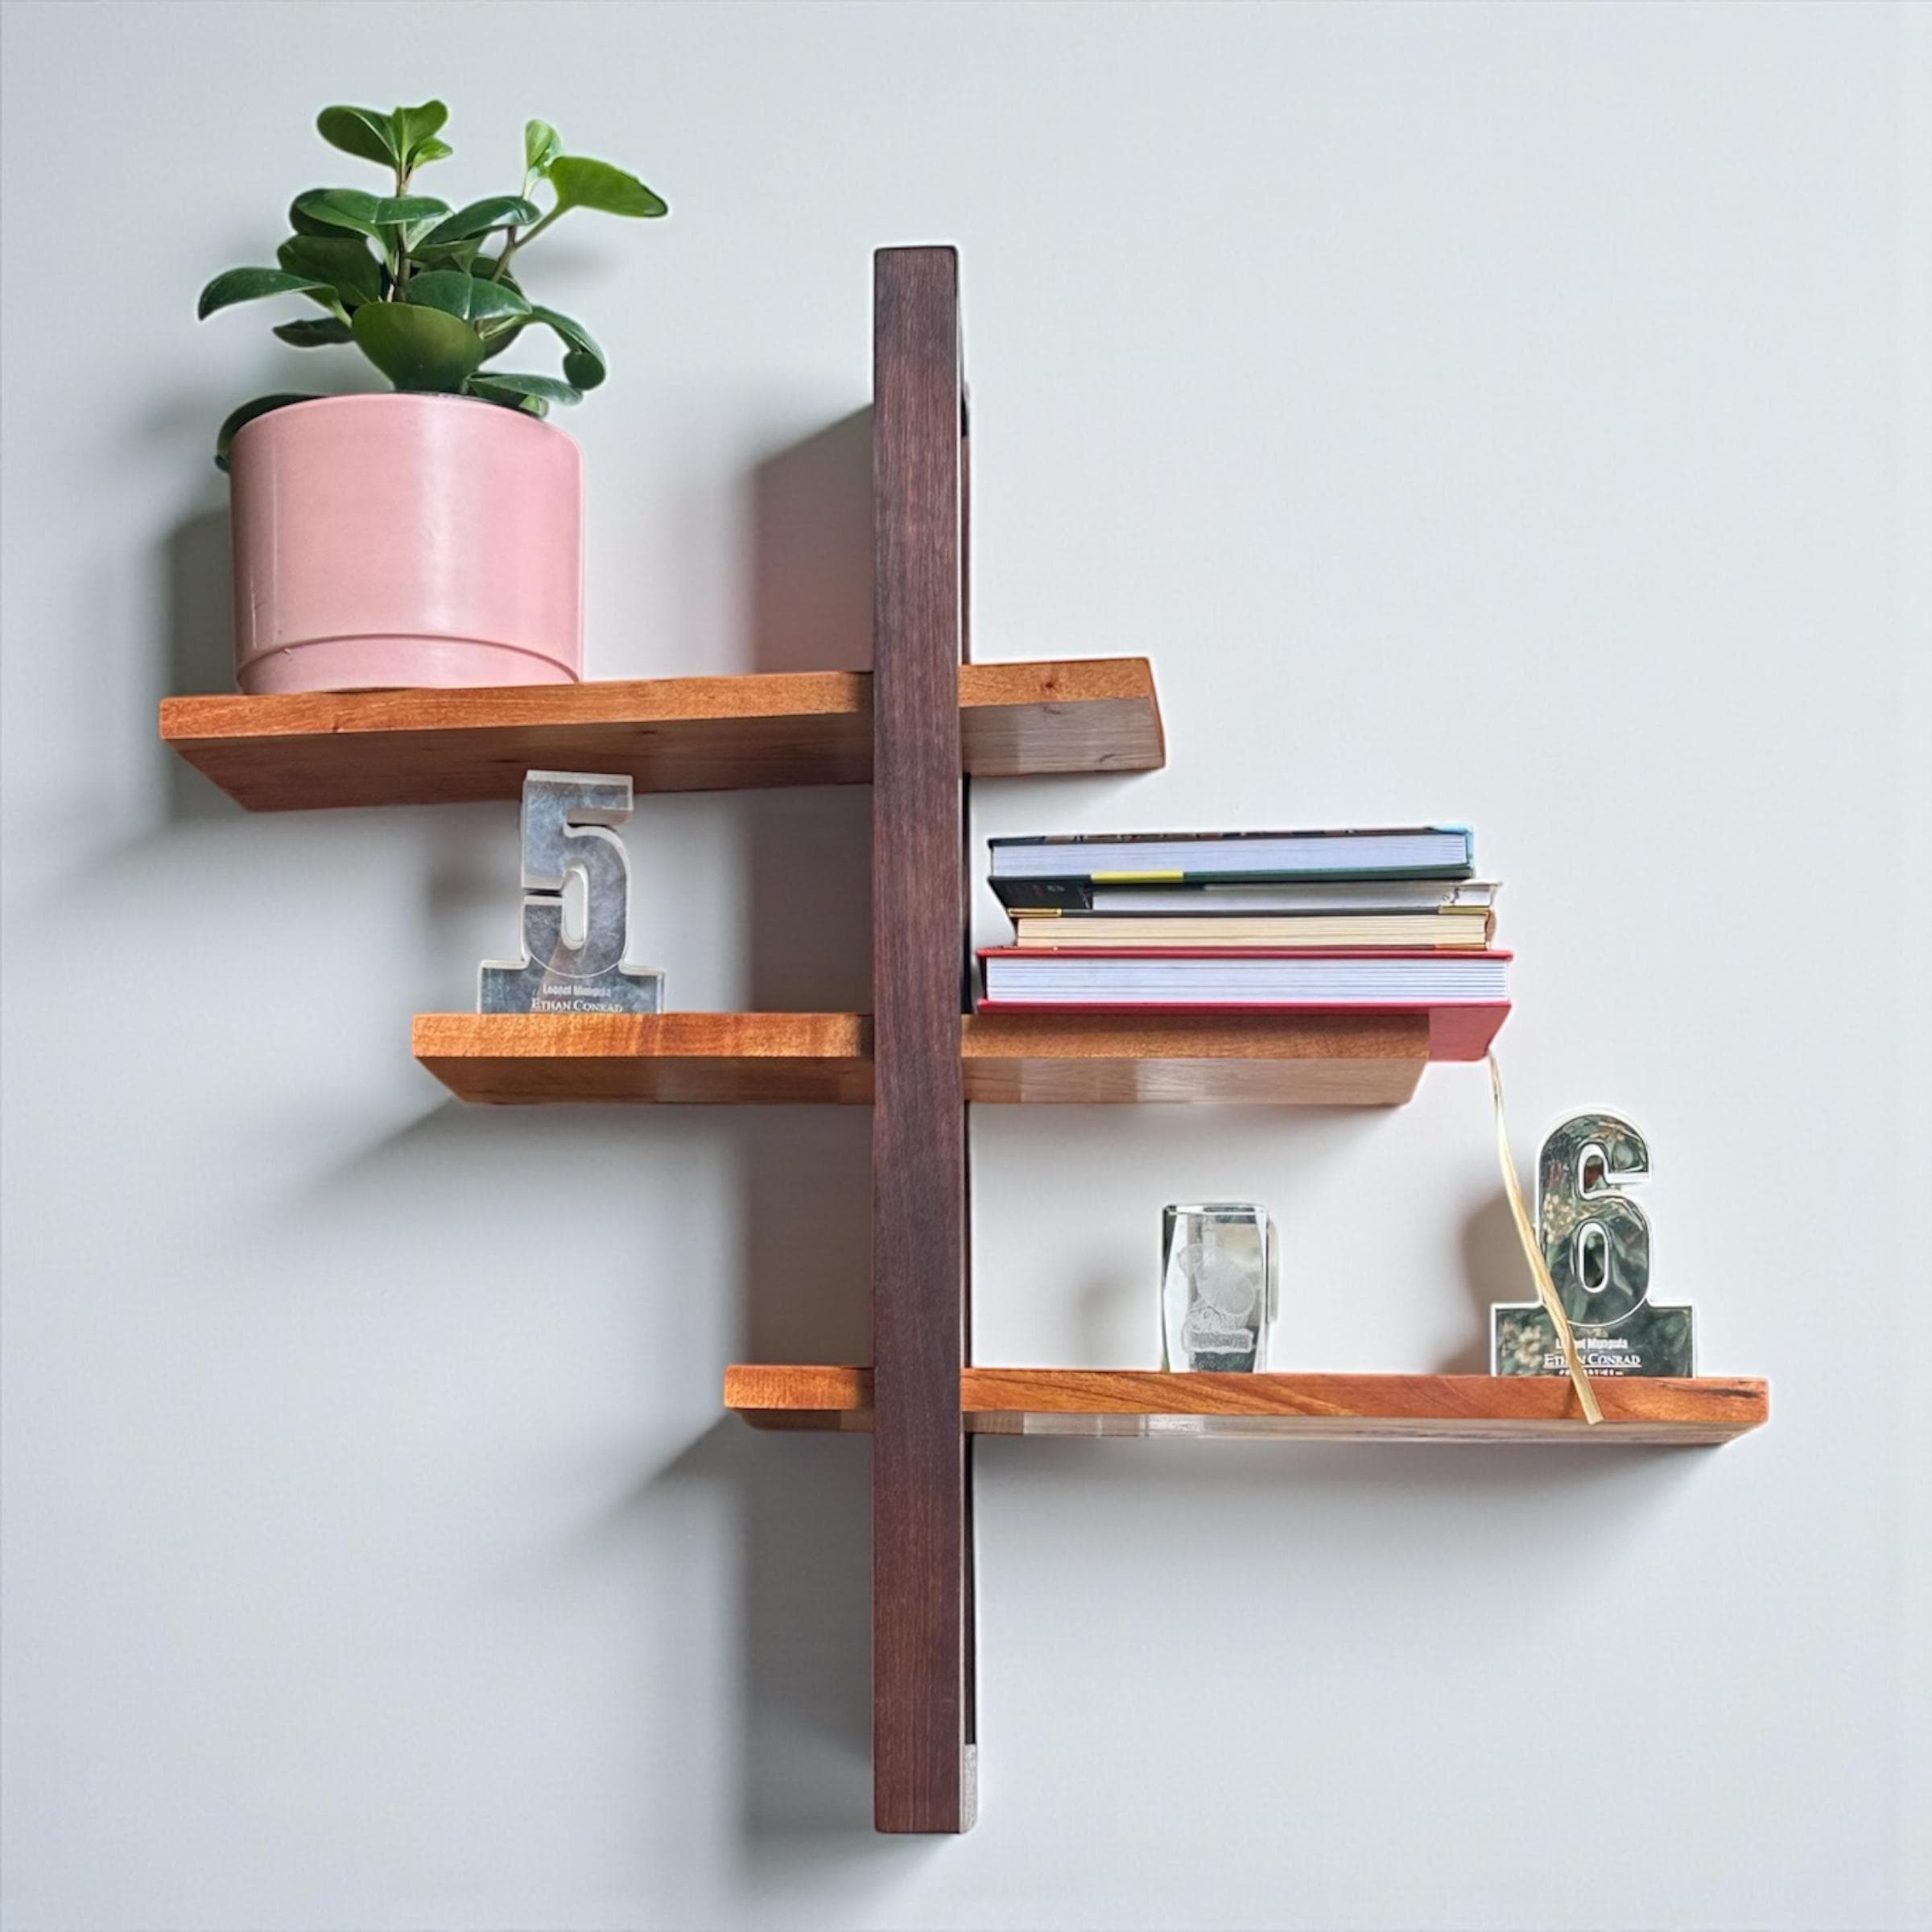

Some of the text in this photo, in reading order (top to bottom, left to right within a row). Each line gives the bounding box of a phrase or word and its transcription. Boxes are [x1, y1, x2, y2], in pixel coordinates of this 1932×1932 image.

[522, 770, 634, 977] 5
[532, 997, 623, 1013] ETHAN CONRAD
[1535, 1108, 1652, 1327] 6
[1587, 1353, 1641, 1365] CONRAD
